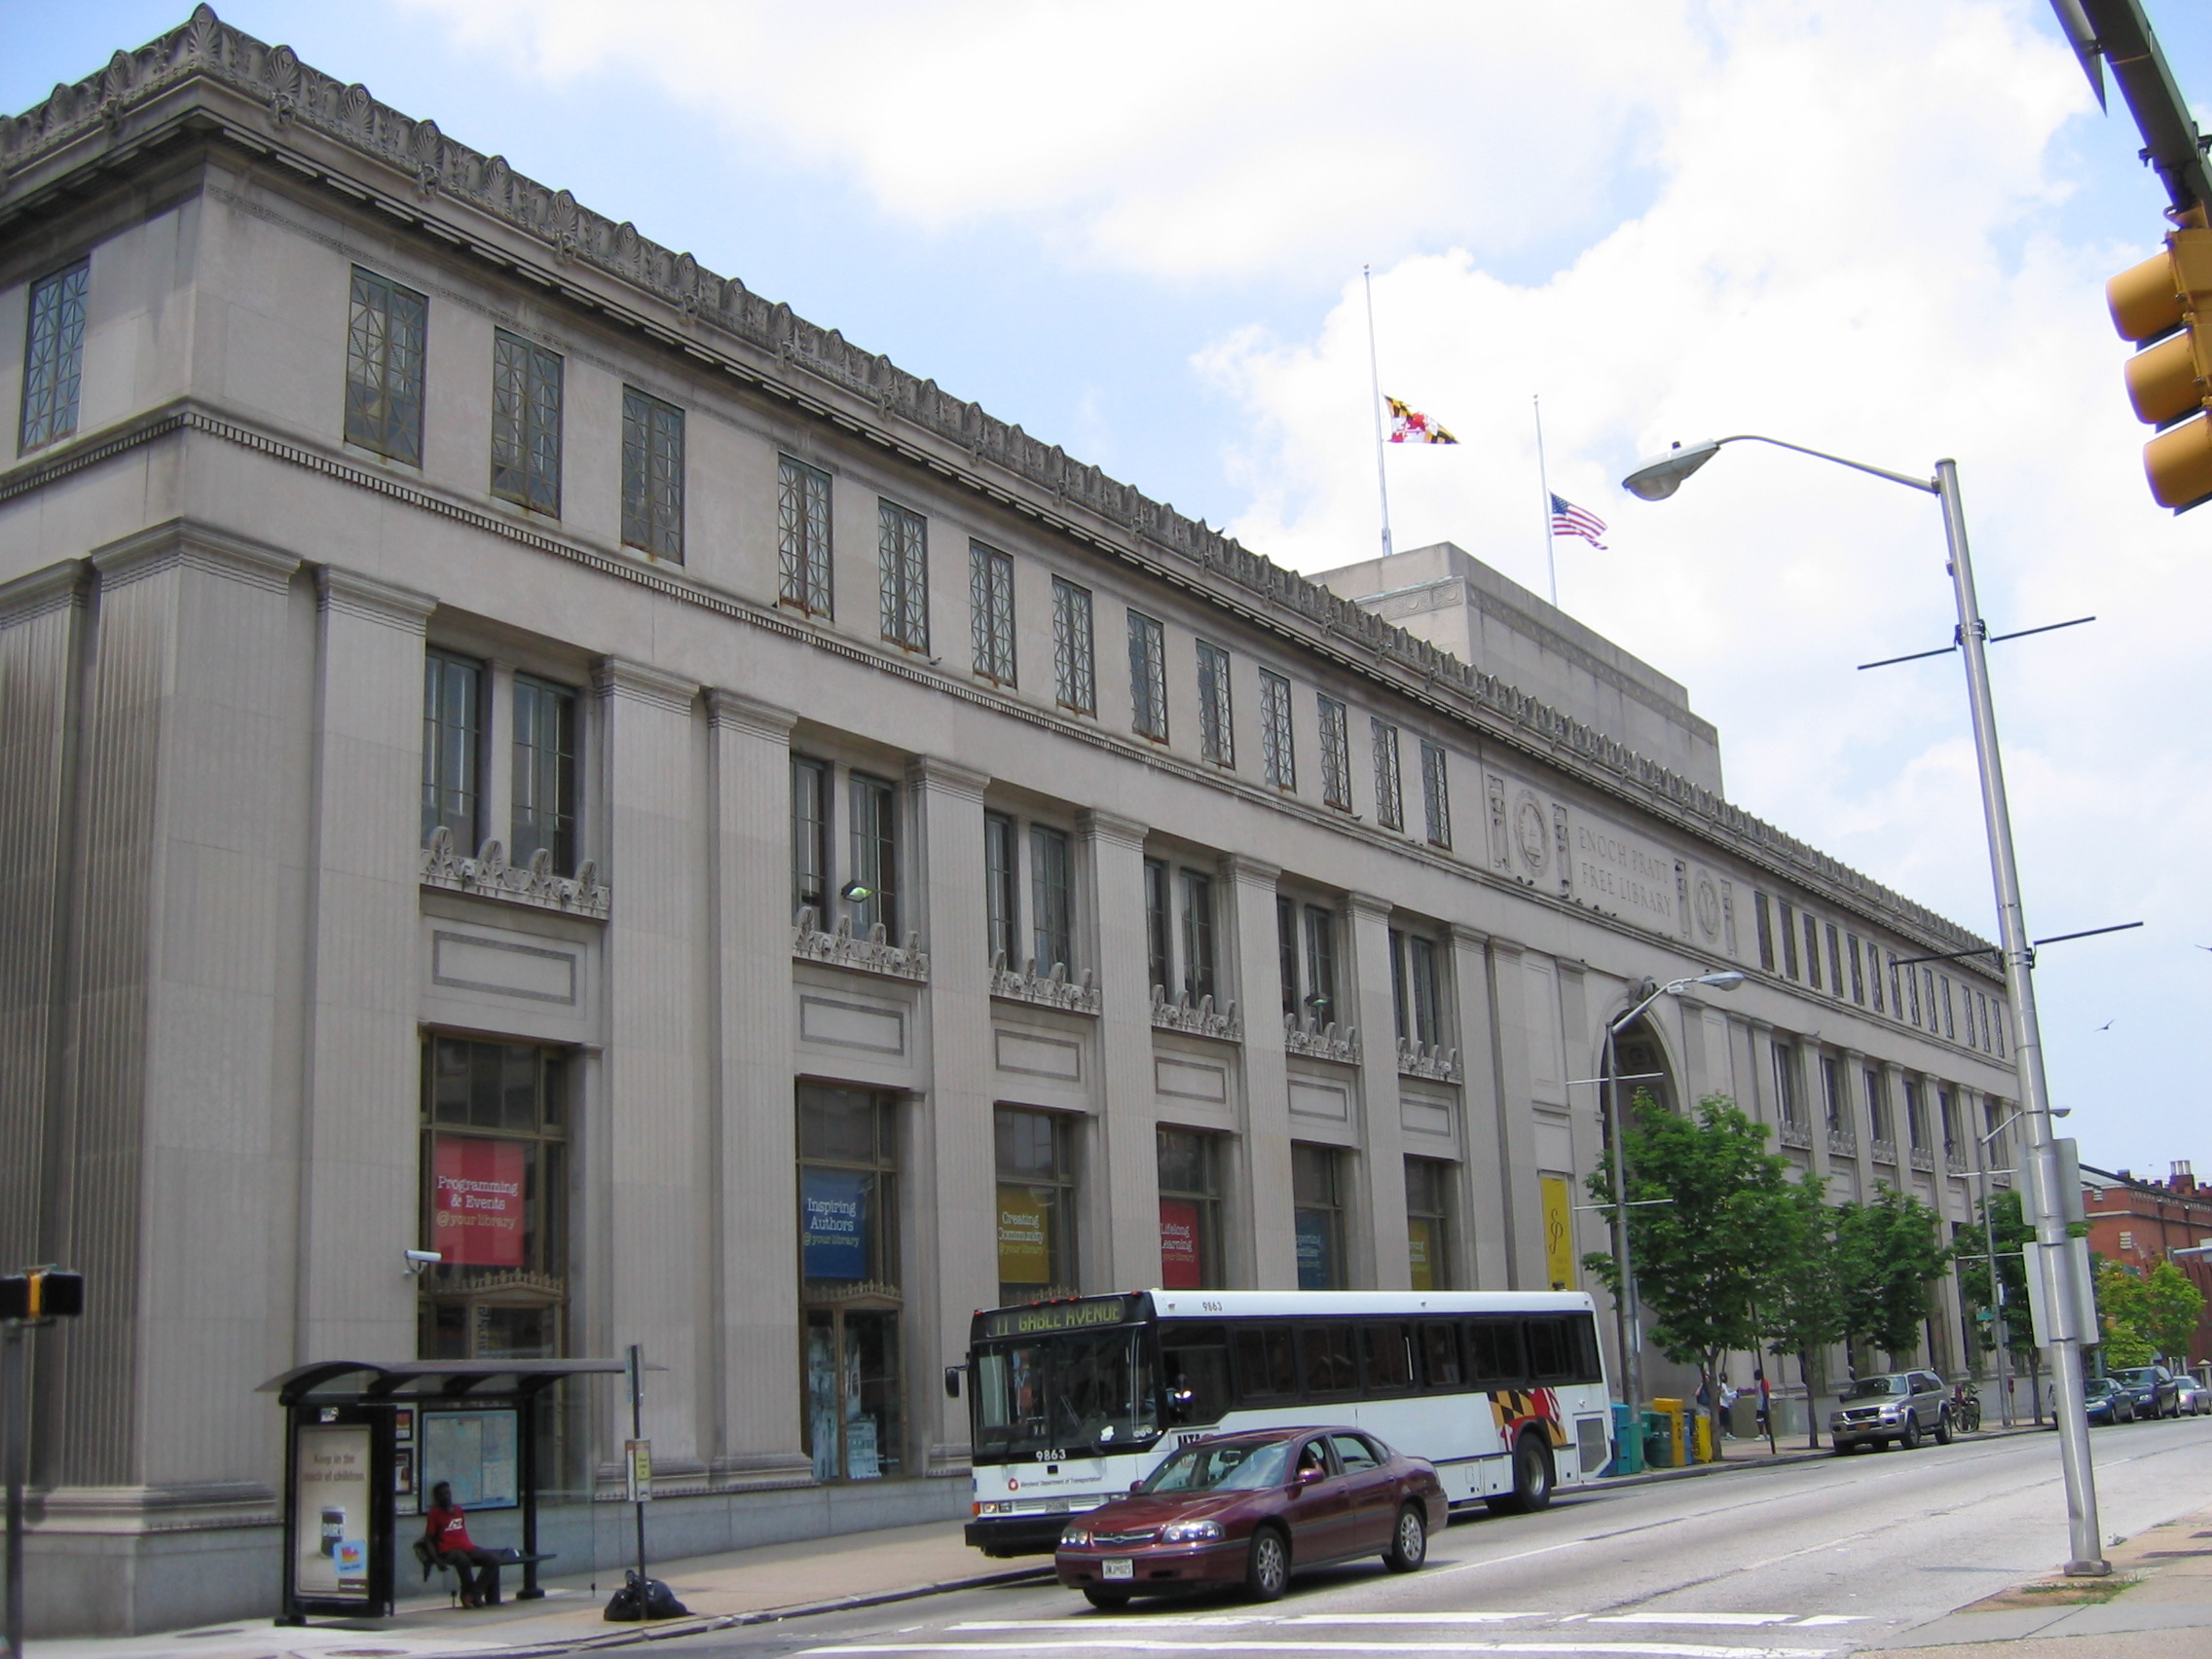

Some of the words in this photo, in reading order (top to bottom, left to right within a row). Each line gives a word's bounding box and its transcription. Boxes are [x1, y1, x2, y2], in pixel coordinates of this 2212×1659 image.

[1579, 826, 1627, 866] ENOCH
[1632, 849, 1667, 884] PRATT
[1582, 862, 1614, 895] FREE
[1619, 877, 1671, 917] LIBRARY
[437, 1175, 519, 1197] Programming
[451, 1194, 462, 1207] &
[465, 1195, 505, 1210] Events
[807, 1198, 857, 1217] Inspiring
[810, 1215, 854, 1232] Authors
[1003, 1211, 1039, 1229] Creating
[1201, 1301, 1223, 1312] 9863
[1018, 1309, 1062, 1332] GABLE
[1065, 1304, 1120, 1327] AVENUE
[1035, 1448, 1067, 1462] 9863
[1040, 1478, 1064, 1487] Department
[1071, 1476, 1103, 1485] Transportation
